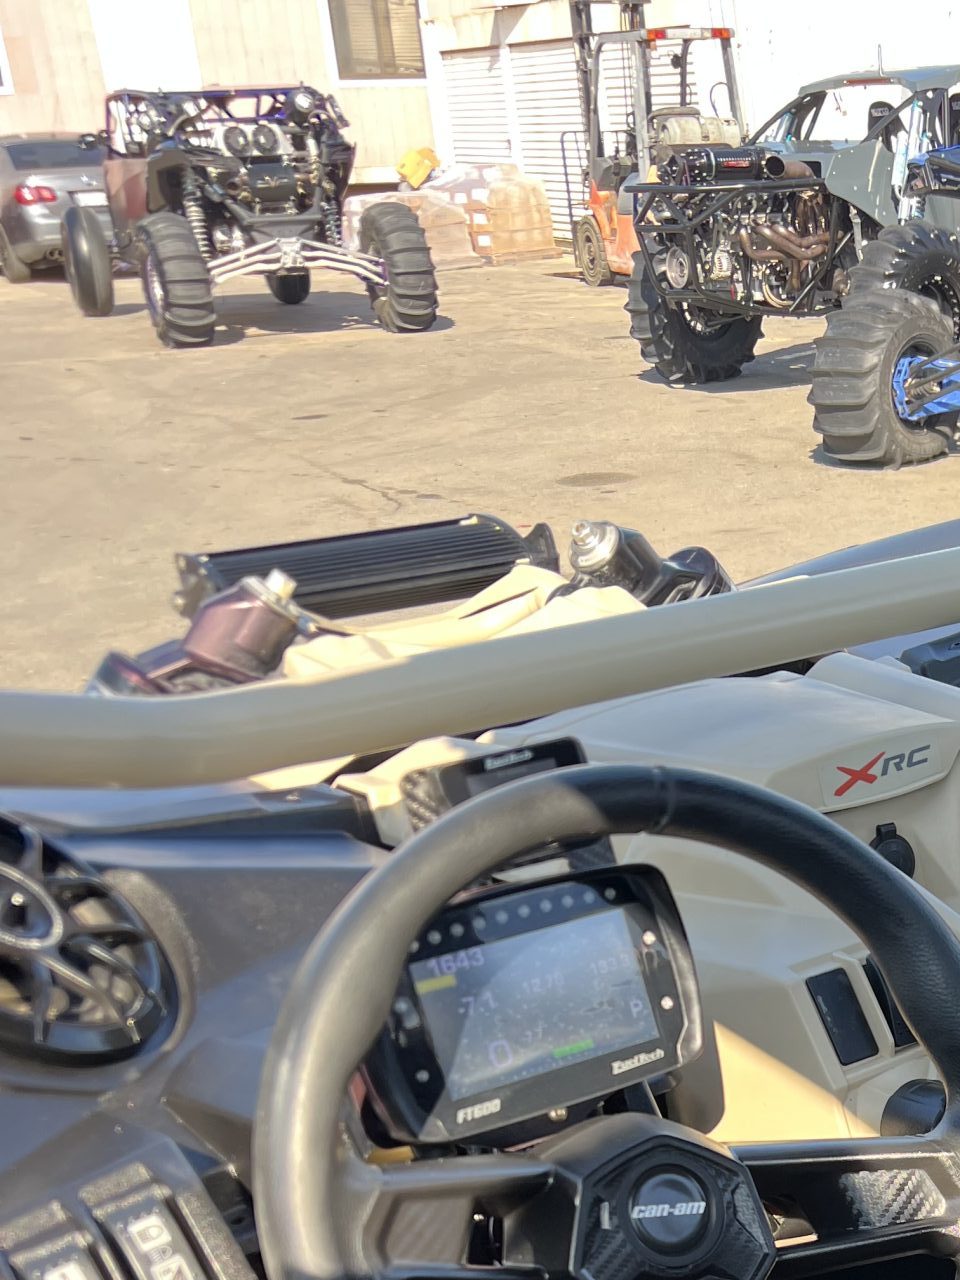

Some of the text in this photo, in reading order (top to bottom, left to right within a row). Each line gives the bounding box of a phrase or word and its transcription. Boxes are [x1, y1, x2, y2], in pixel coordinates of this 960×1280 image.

[834, 745, 931, 797] XRC
[427, 948, 484, 977] 1643
[630, 999, 643, 1019] P
[456, 1098, 501, 1124] FT600
[631, 1201, 706, 1219] can-am
